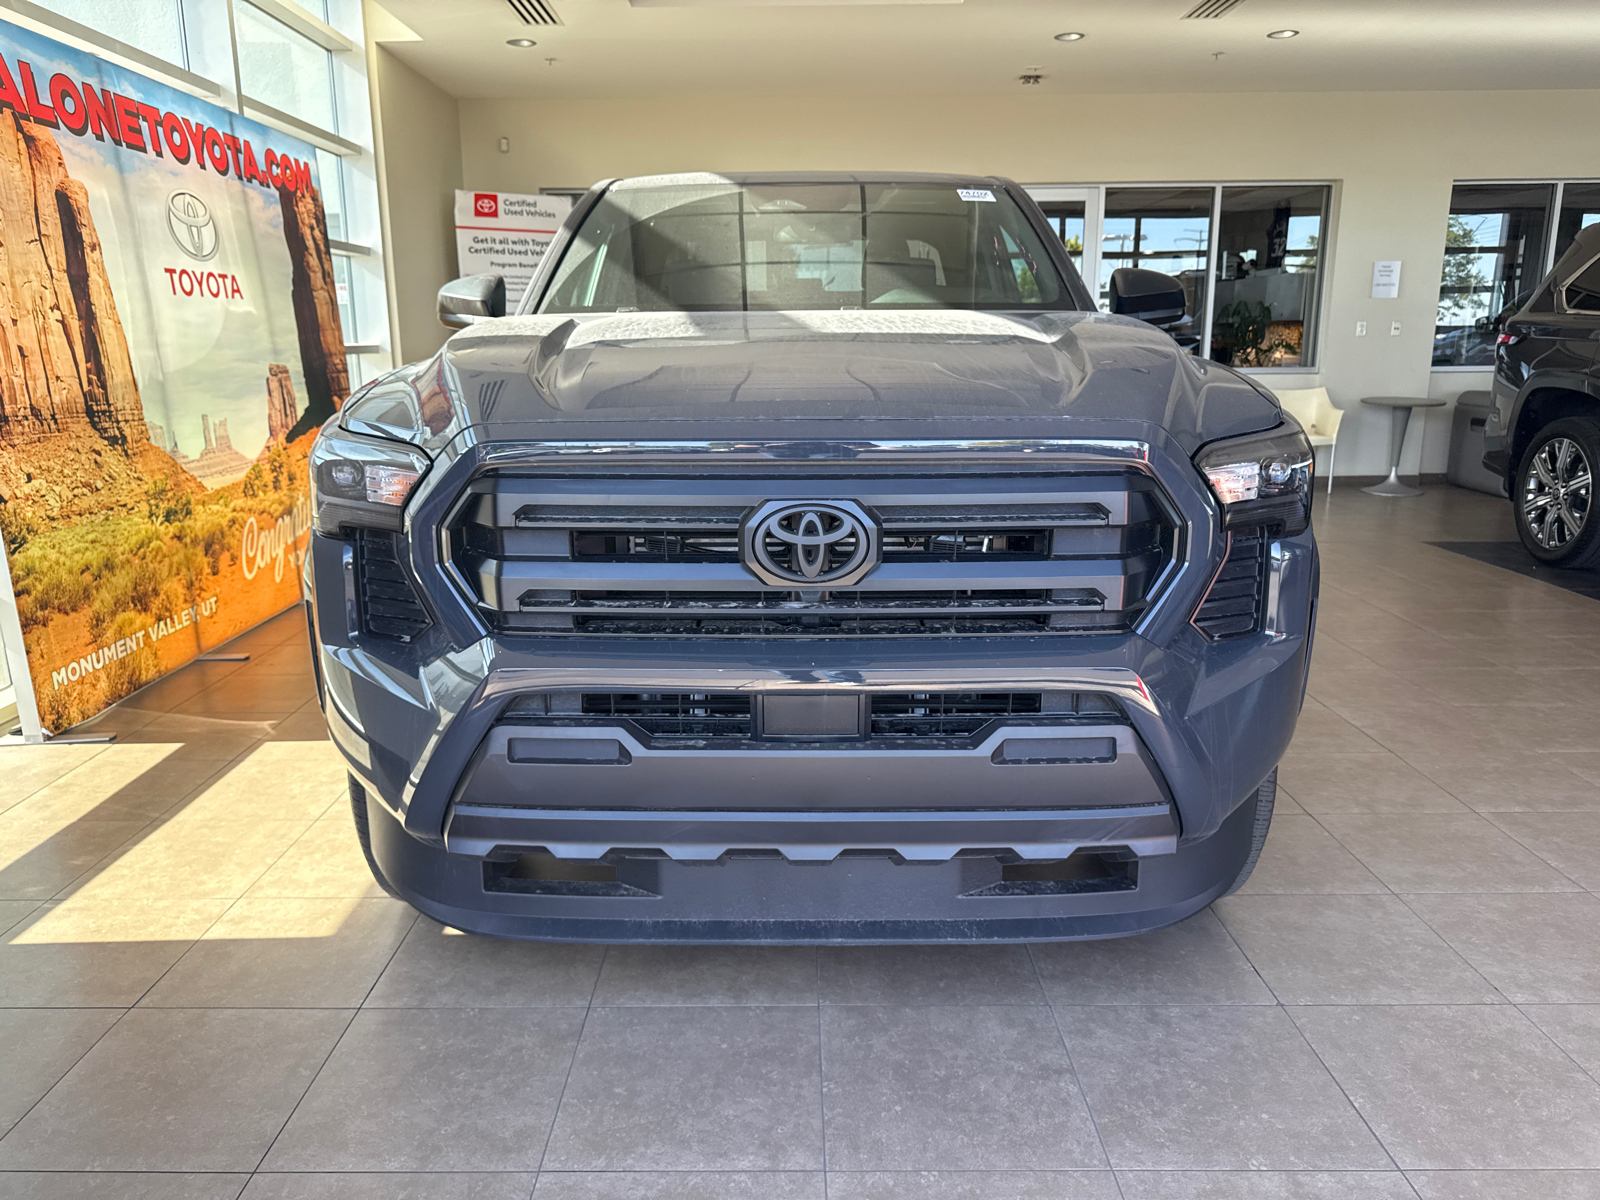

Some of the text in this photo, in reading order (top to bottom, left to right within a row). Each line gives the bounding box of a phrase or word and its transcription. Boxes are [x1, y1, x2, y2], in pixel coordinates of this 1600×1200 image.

[503, 198, 537, 208] Certified
[503, 208, 556, 218] Used Vehicles
[472, 236, 489, 245] Get
[490, 236, 496, 245] it
[498, 237, 509, 245] all
[510, 238, 529, 246] with
[468, 246, 505, 255] Certified
[507, 248, 528, 256] Used
[1270, 237, 1286, 257] 32
[490, 261, 517, 269] Program
[164, 267, 244, 300] TOYOTA
[51, 596, 218, 691] MONUMENT VALLEY, UT
